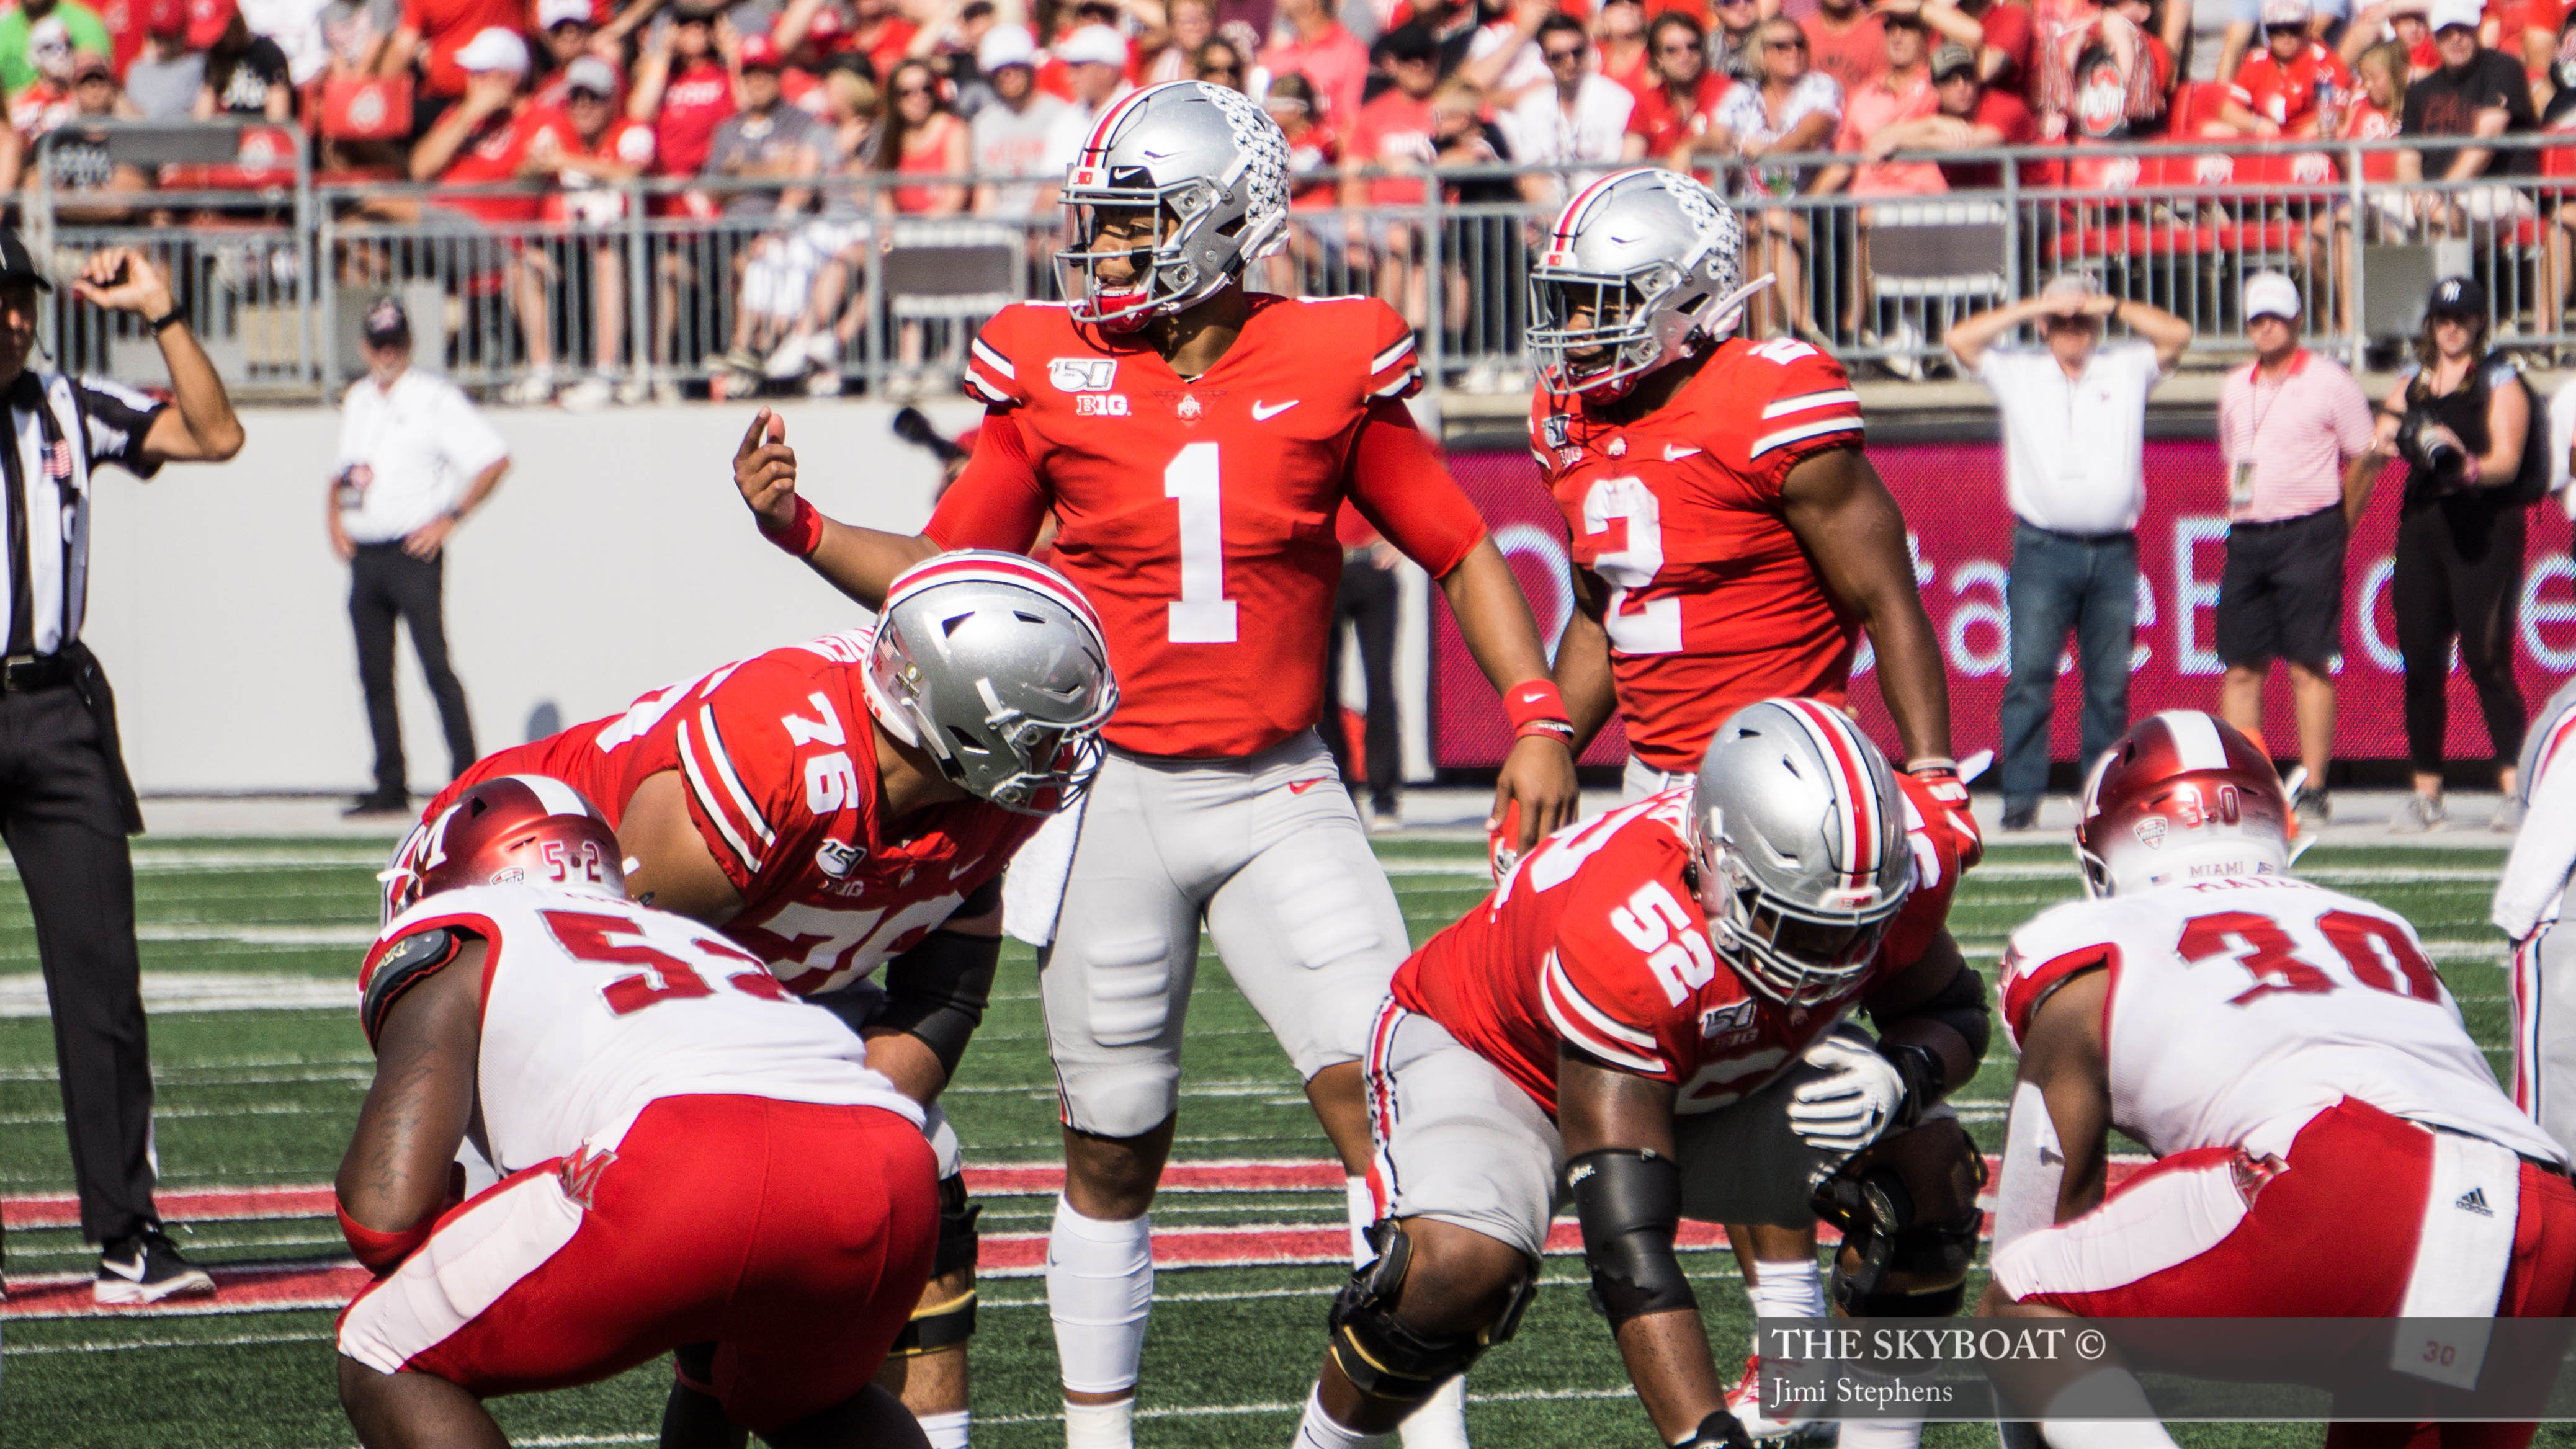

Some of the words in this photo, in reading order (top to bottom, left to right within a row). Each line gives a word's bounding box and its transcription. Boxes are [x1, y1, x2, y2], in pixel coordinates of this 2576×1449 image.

[1164, 442, 1237, 643] 1
[1583, 476, 1684, 654] 2
[780, 691, 859, 815] 76
[540, 840, 602, 883] 52
[2189, 861, 2245, 878] MIAMI
[1609, 879, 1716, 1009] 52
[2173, 908, 2443, 1009] 30
[2423, 1340, 2456, 1367] 30
